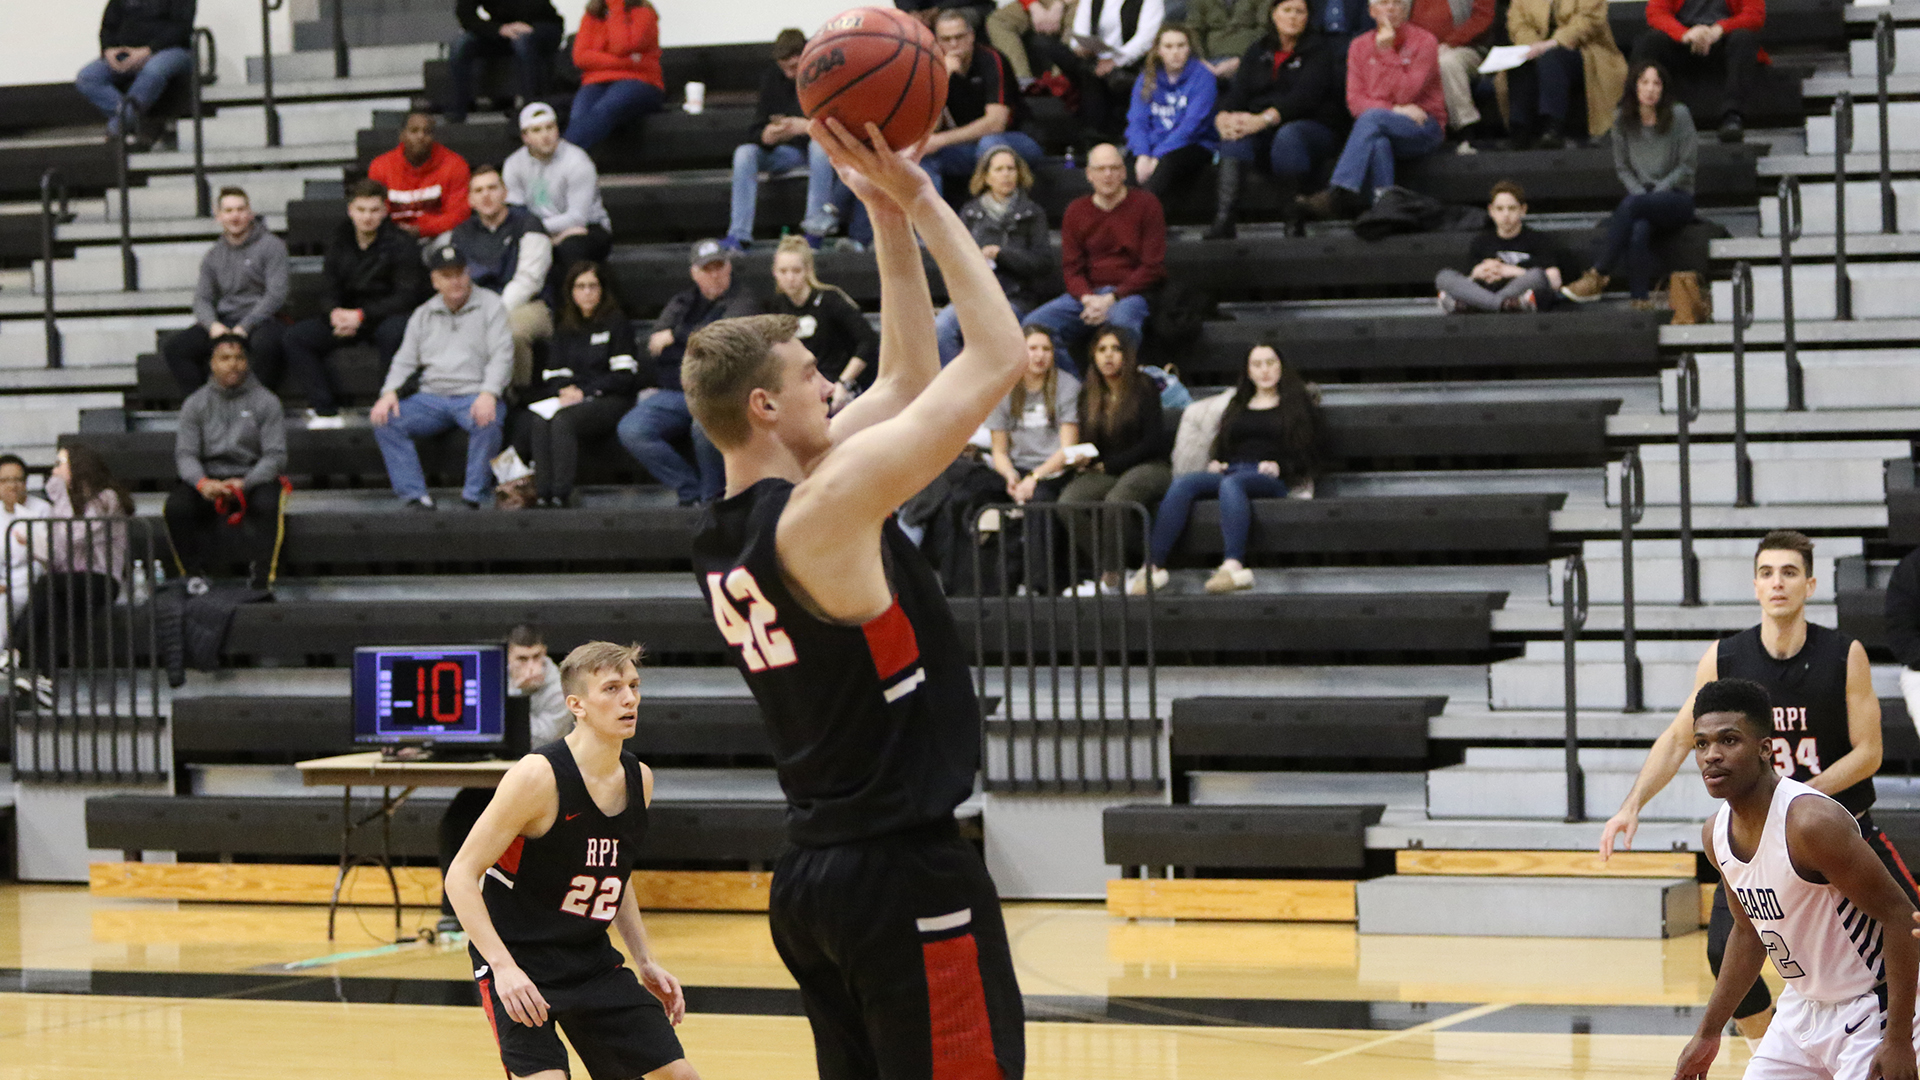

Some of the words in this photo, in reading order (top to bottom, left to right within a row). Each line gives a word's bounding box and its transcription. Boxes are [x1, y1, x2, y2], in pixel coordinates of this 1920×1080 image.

[706, 565, 799, 674] 42
[1772, 706, 1808, 732] RPI
[1771, 736, 1822, 778] 34
[585, 837, 619, 867] RPI
[559, 874, 622, 921] 22
[1736, 887, 1785, 921] BARD
